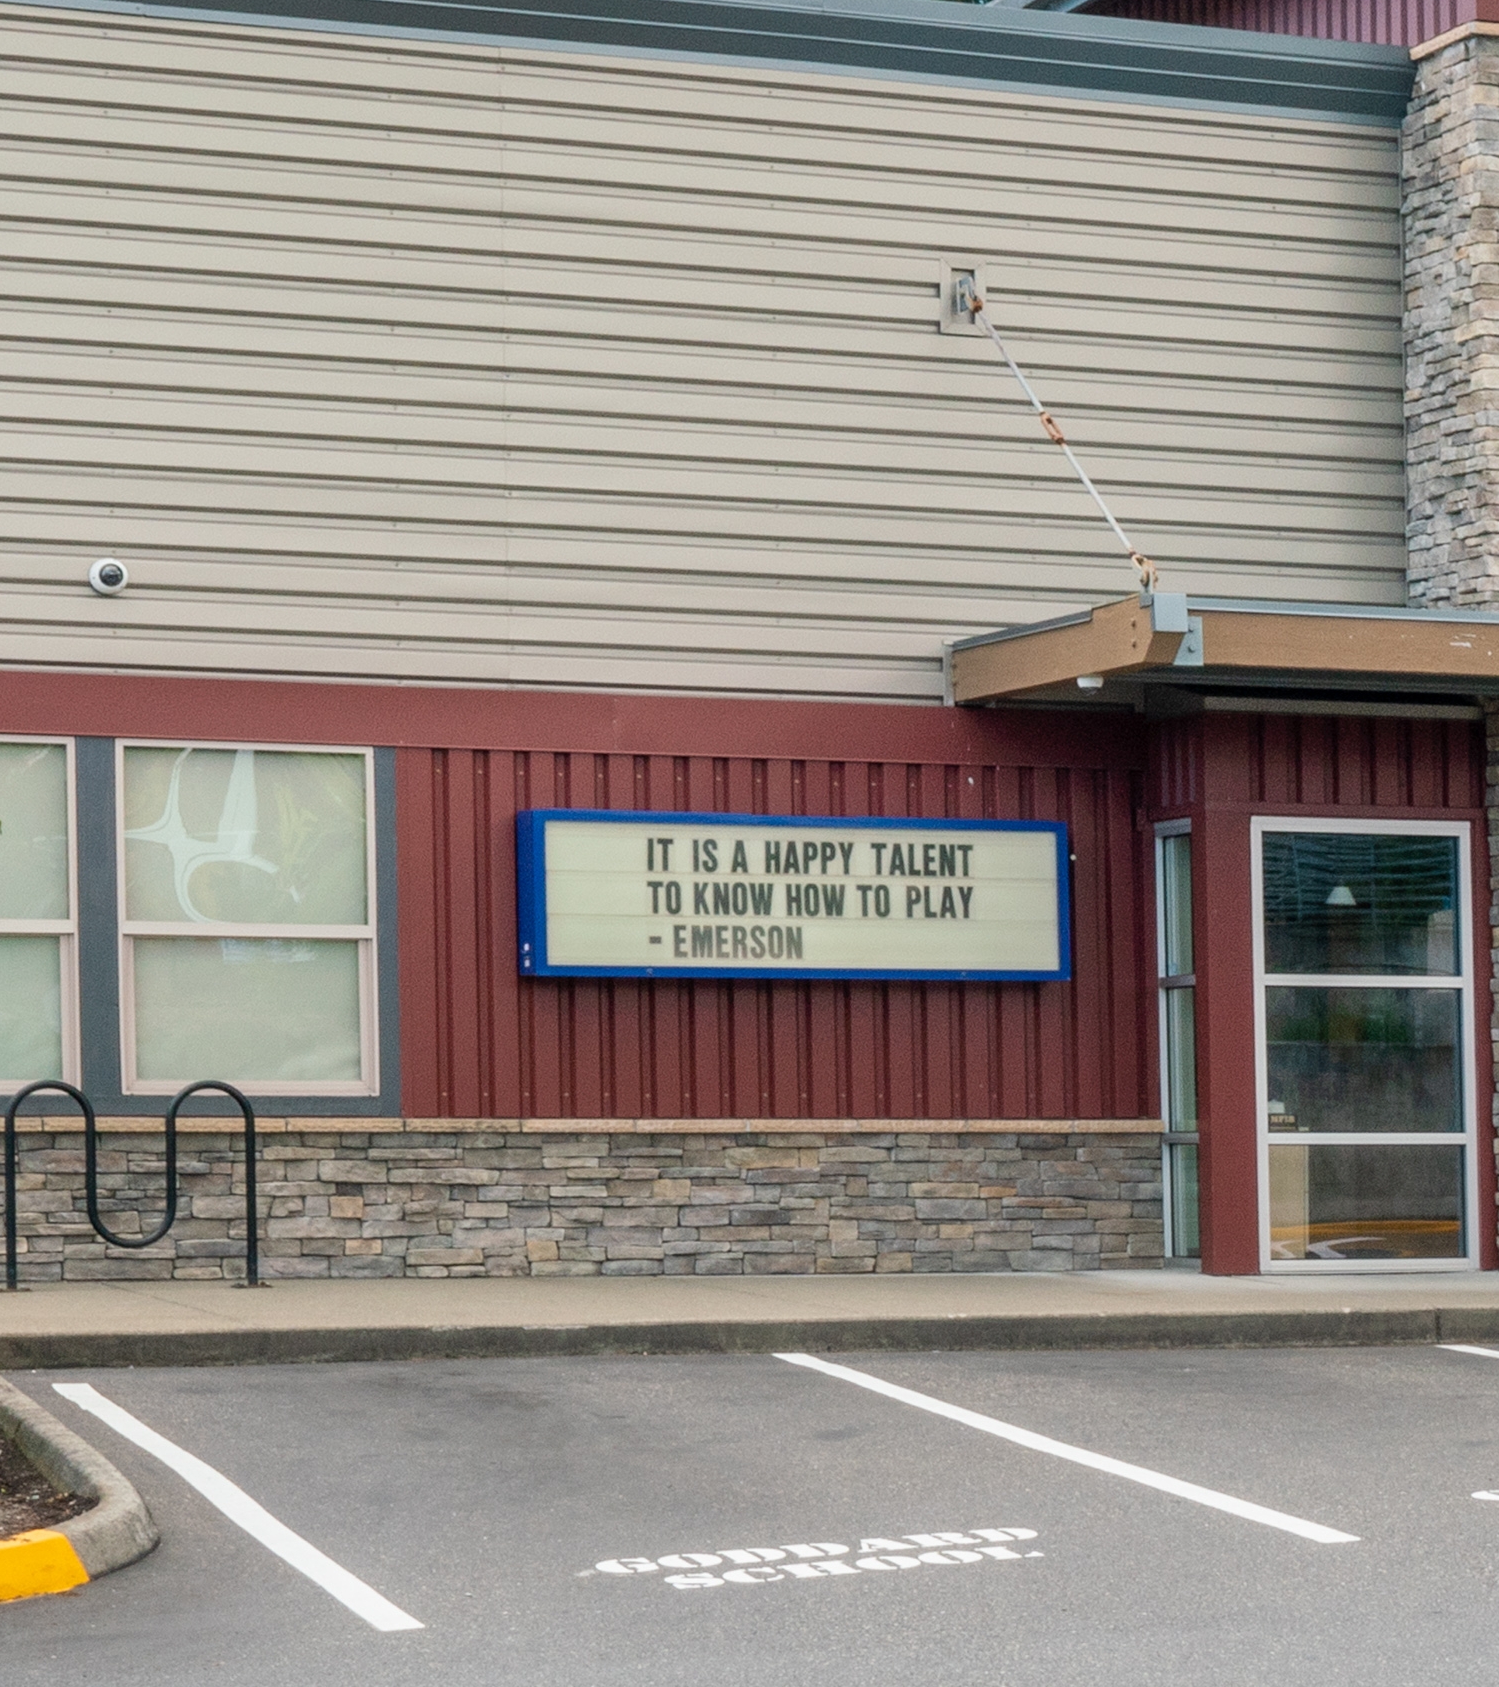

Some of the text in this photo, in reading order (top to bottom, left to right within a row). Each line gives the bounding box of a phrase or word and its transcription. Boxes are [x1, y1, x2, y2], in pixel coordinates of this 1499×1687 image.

[646, 837, 974, 877] IT IS A HAPPY TALENT
[646, 880, 974, 919] TO KNOW HOW TO PLAY
[673, 924, 804, 959] EMERSON
[594, 1527, 1039, 1574] GODDARD
[664, 1546, 1045, 1589] SCHOOL
